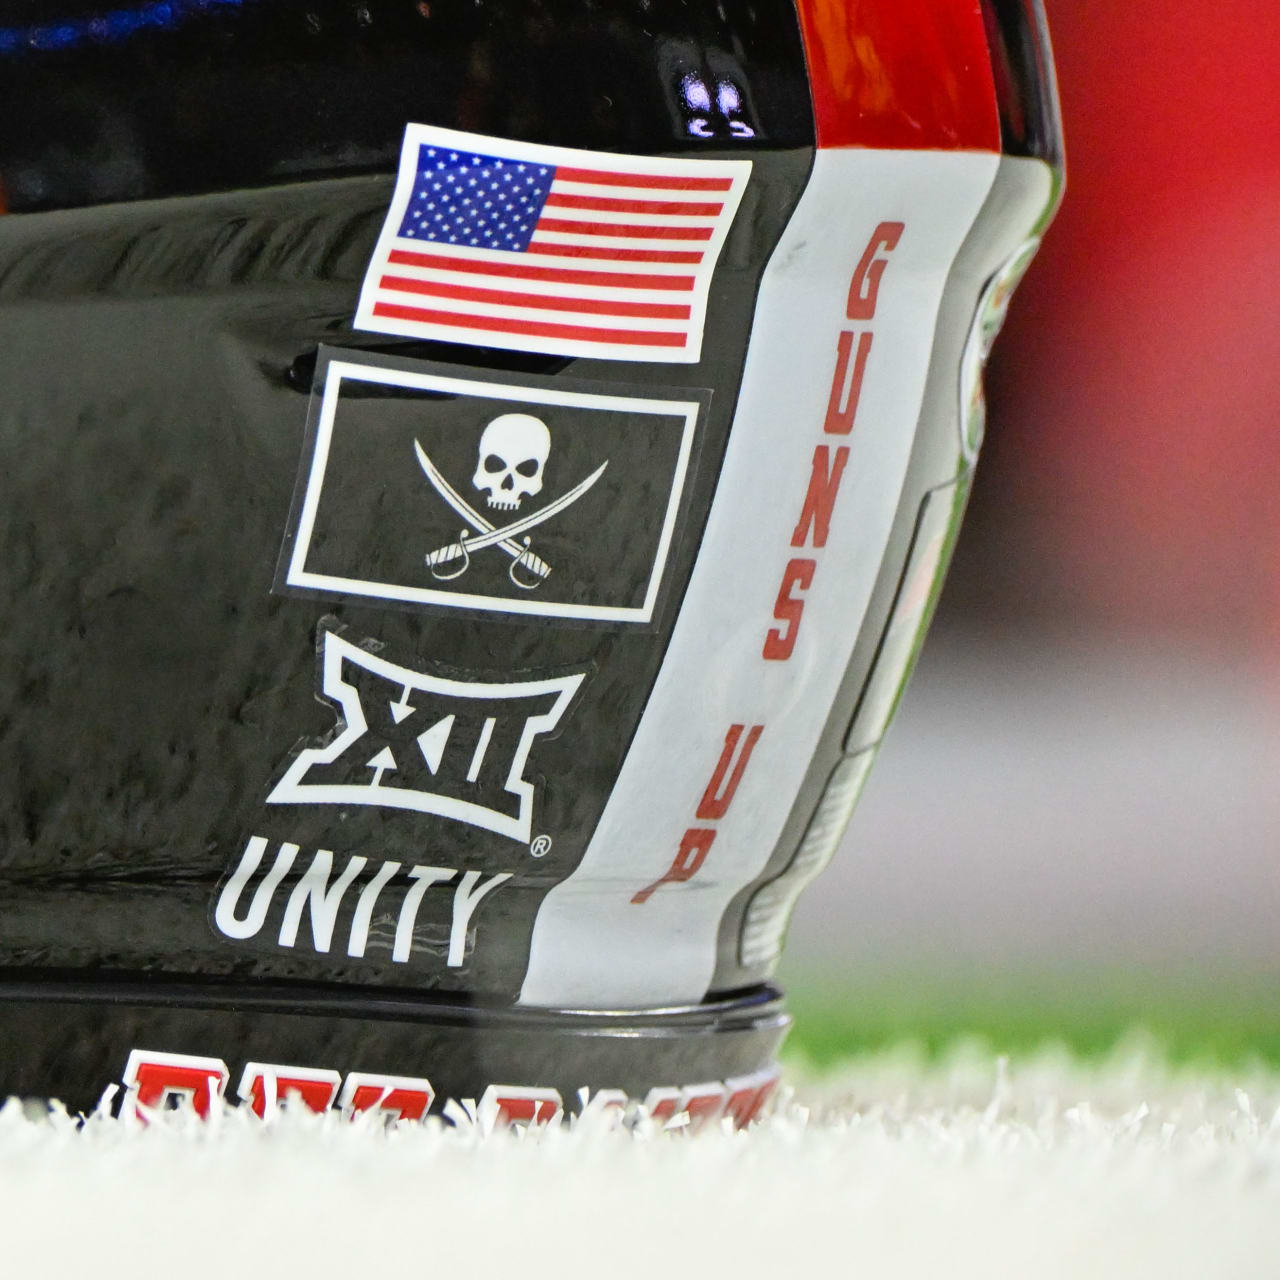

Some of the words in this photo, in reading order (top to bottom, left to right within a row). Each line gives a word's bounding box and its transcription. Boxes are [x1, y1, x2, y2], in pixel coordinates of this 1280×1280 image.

[762, 221, 906, 662] GUNS
[214, 835, 515, 968] UNITY
[630, 723, 764, 905] UP
